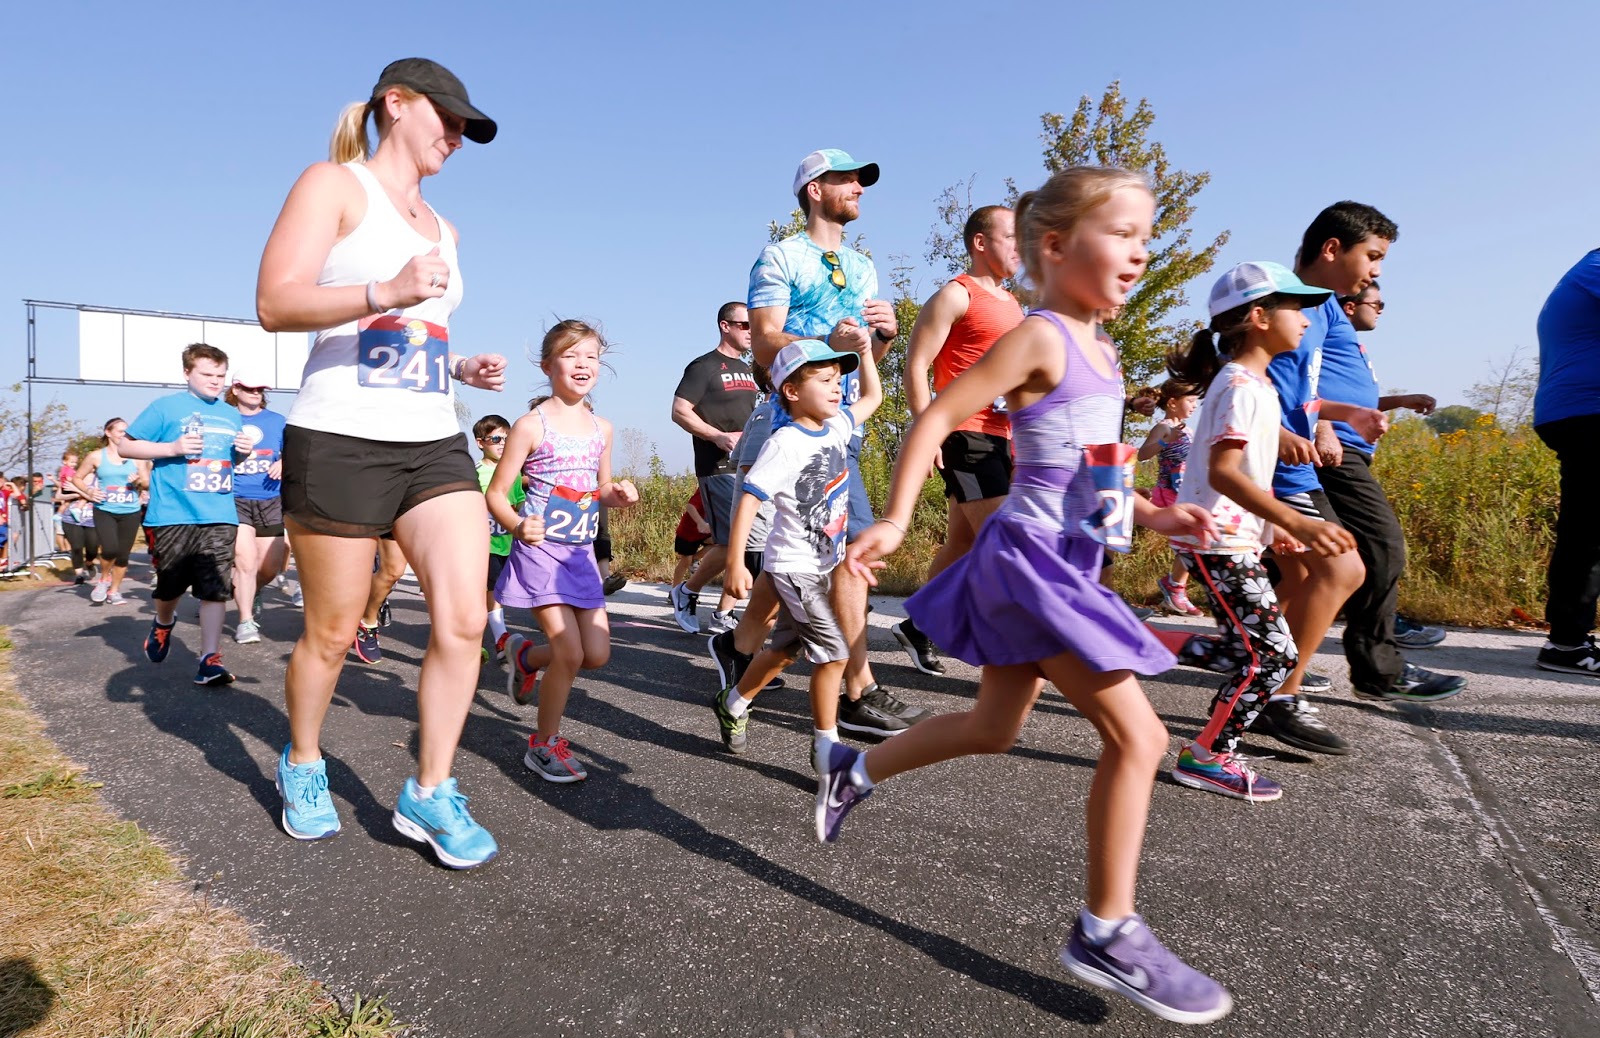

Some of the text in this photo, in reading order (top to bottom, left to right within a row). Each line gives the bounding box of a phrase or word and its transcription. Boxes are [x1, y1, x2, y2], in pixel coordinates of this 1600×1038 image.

[368, 346, 446, 390] 241
[189, 472, 232, 492] 334
[107, 492, 133, 503] 264
[545, 509, 600, 540] 243
